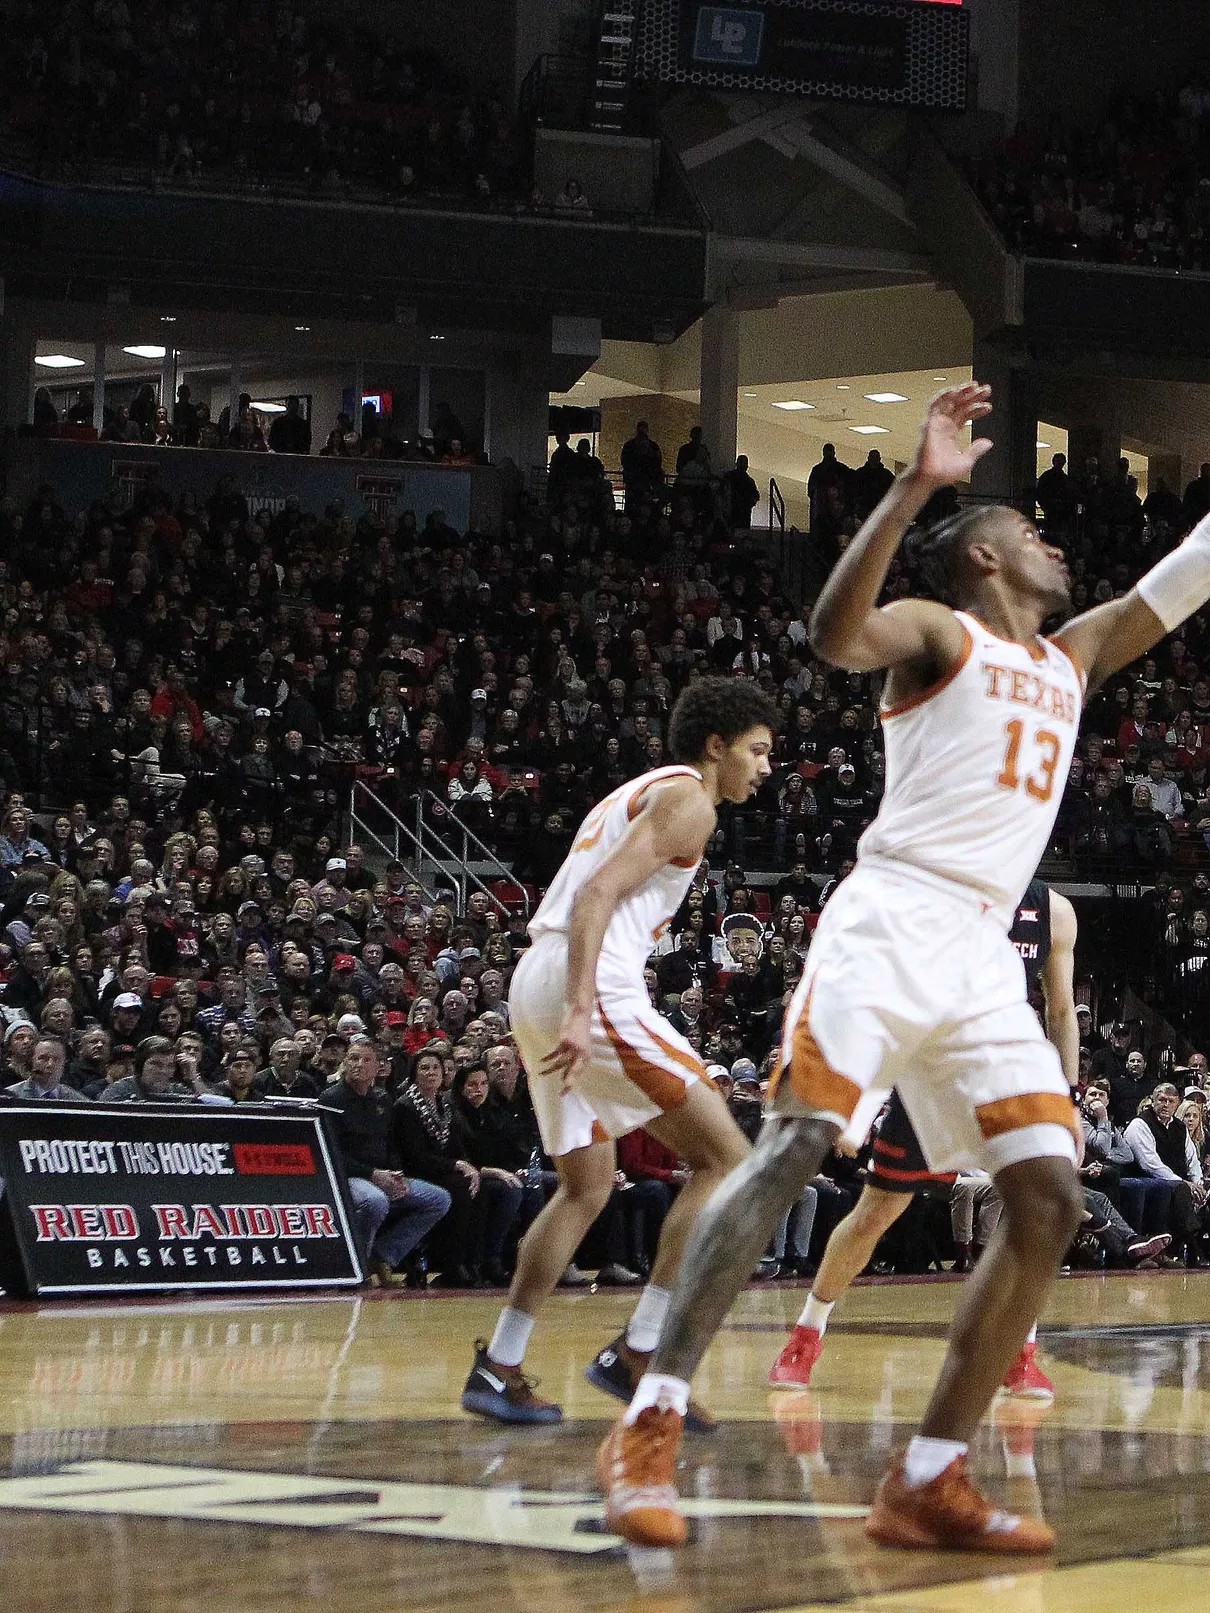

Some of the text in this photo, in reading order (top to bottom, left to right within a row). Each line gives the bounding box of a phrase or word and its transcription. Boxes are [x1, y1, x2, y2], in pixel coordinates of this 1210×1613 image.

[983, 663, 1076, 724] TEXAS
[996, 717, 1061, 803] 13
[18, 1139, 118, 1174] PROTECT
[117, 1141, 160, 1174] THIS
[28, 1204, 340, 1242] RED RAIDER
[86, 1246, 308, 1268] BASKETBALL
